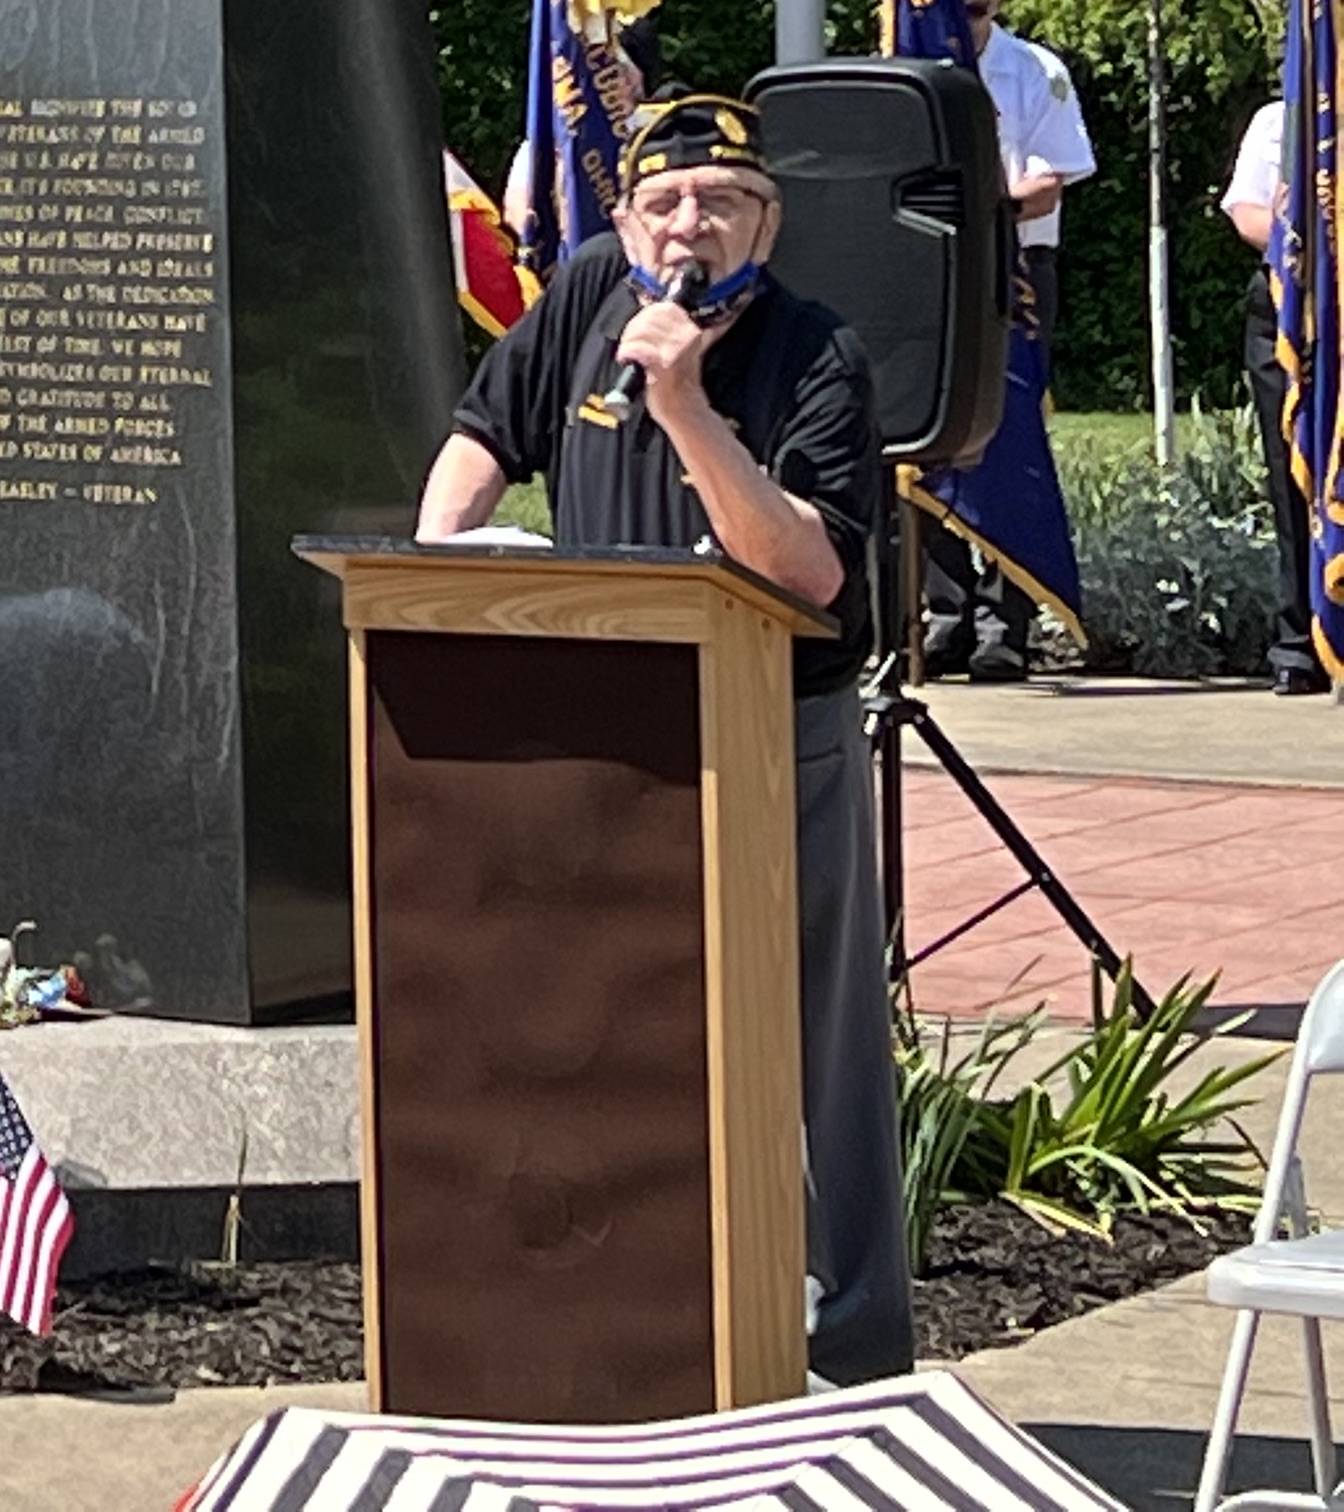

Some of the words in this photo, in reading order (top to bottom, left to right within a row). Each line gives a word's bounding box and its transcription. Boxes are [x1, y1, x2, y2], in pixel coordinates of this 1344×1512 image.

[111, 98, 142, 117] THE
[85, 125, 105, 144] OF
[111, 124, 142, 144] THE
[58, 150, 98, 170] HAVE
[53, 178, 136, 197] FOUNDING
[140, 180, 160, 196] IN
[39, 203, 58, 221] OF
[28, 230, 66, 248] HAVE
[73, 231, 132, 250] HELPED
[136, 232, 213, 252] PRESERVE
[117, 258, 152, 277] AND
[156, 258, 213, 278] IDEALS
[63, 283, 83, 301] AS
[86, 284, 116, 303] THE
[123, 285, 214, 304] DEDICATION
[10, 307, 30, 326] OF
[36, 308, 69, 327] OUR
[76, 310, 158, 329] VETERANS
[164, 312, 205, 332] HAVE
[36, 335, 57, 353] OF
[111, 338, 134, 356] WE
[140, 339, 182, 358] HOPE
[99, 365, 132, 382] OUR
[140, 365, 212, 387] ETERNAL
[16, 388, 105, 408] GRATITUDE
[112, 391, 134, 410] TO
[139, 391, 171, 411] ALL
[17, 413, 47, 433] THE
[54, 416, 110, 435] ARMED
[114, 417, 176, 438] FORCES
[22, 440, 77, 461] STATES
[82, 443, 103, 463] OF
[110, 445, 181, 465] AMERICA
[83, 483, 158, 504] VETERAN
